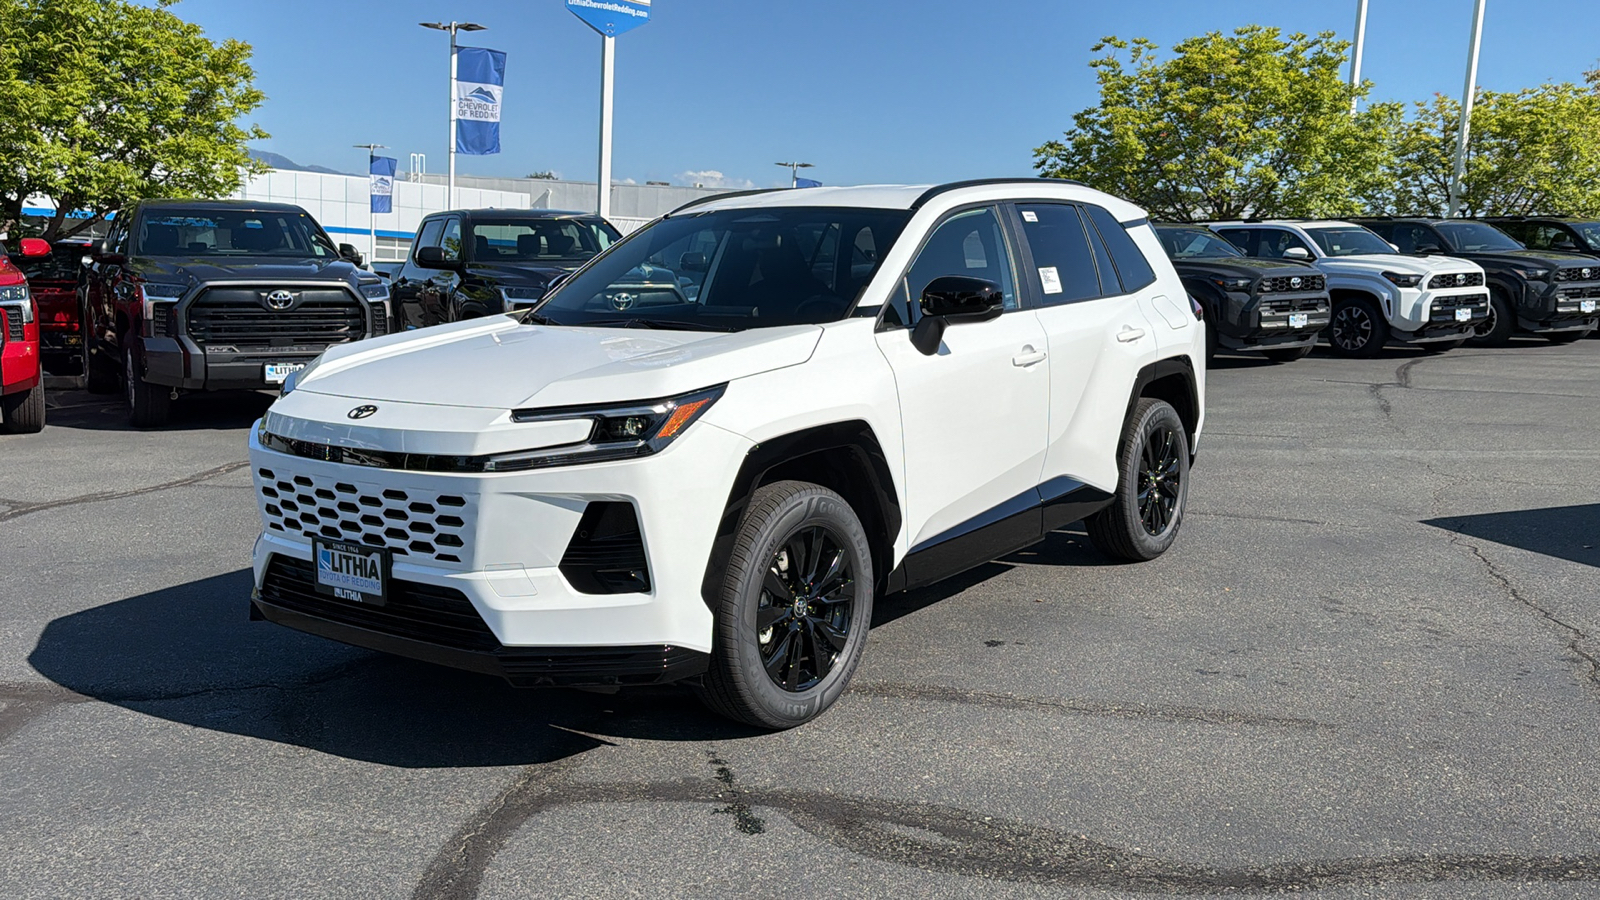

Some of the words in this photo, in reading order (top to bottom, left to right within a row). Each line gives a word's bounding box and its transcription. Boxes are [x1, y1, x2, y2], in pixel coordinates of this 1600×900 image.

[458, 101, 498, 111] CHEVROLET
[458, 108, 468, 117] OF
[332, 543, 347, 551] SINCE
[331, 552, 380, 580] LITHIA
[319, 570, 341, 582] TOYOTA
[341, 575, 350, 584] OF
[351, 576, 380, 590] REDDING
